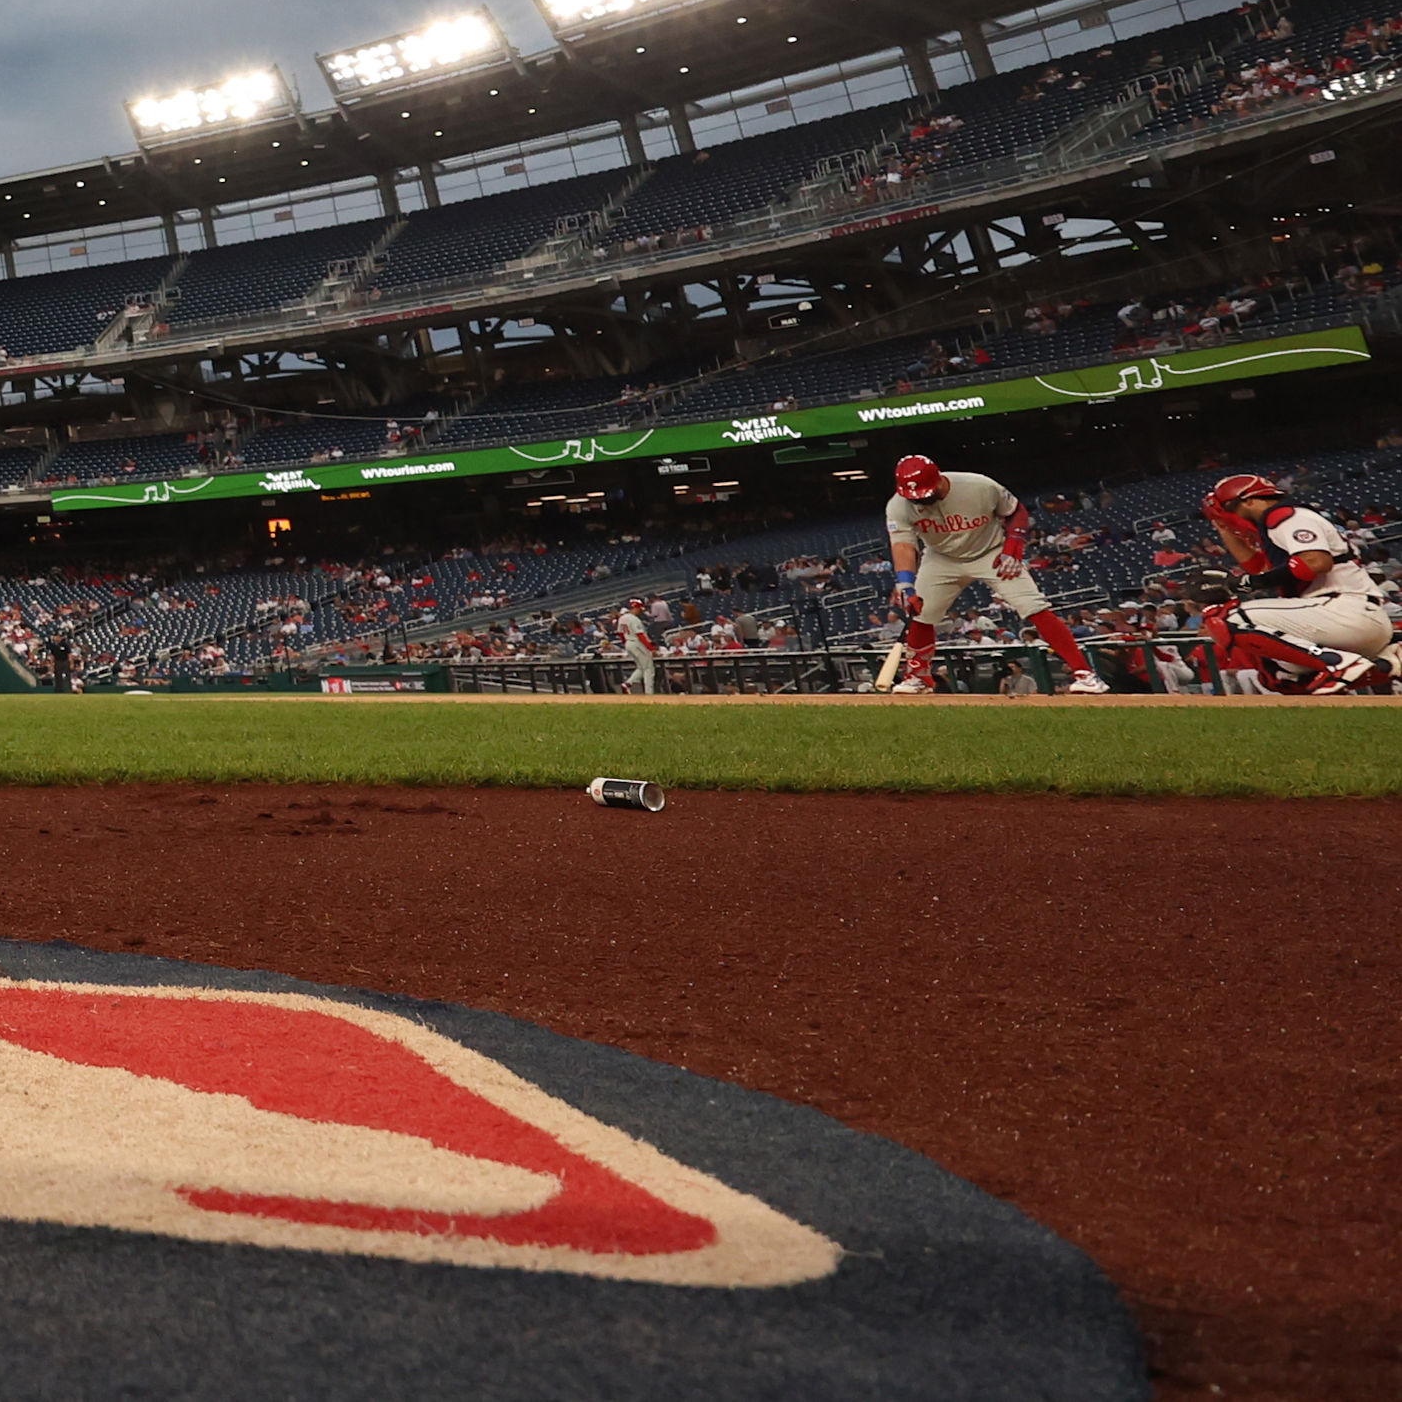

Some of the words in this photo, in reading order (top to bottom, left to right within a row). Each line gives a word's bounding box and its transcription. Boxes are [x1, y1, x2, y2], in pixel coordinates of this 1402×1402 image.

[857, 396, 985, 423] WVtourism.com
[732, 416, 778, 431] WEST
[722, 425, 802, 443] VIRGINIA
[266, 470, 304, 482] WEST
[360, 462, 456, 480] WVtourism.com
[258, 478, 322, 493] VIRGINIA
[913, 514, 991, 534] Phillies
